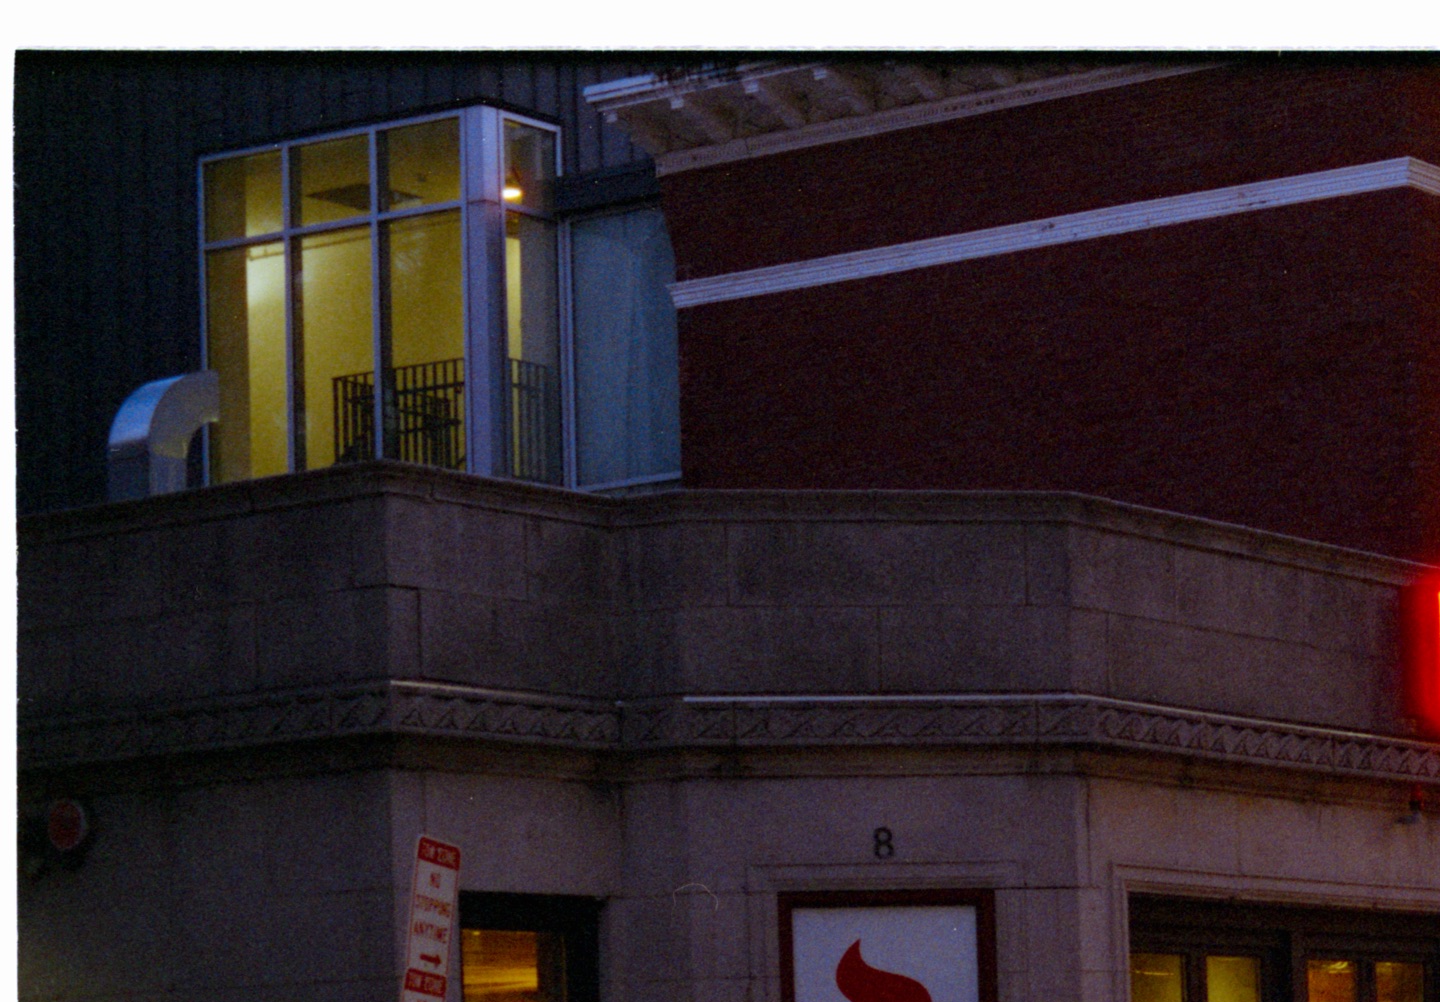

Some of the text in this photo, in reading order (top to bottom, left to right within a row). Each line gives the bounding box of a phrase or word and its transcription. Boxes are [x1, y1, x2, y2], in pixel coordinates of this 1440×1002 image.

[873, 827, 894, 859] 8
[437, 846, 457, 865] ZONE
[430, 872, 441, 888] NO
[416, 894, 451, 918] STOPPING
[414, 920, 448, 944] ANYTIME
